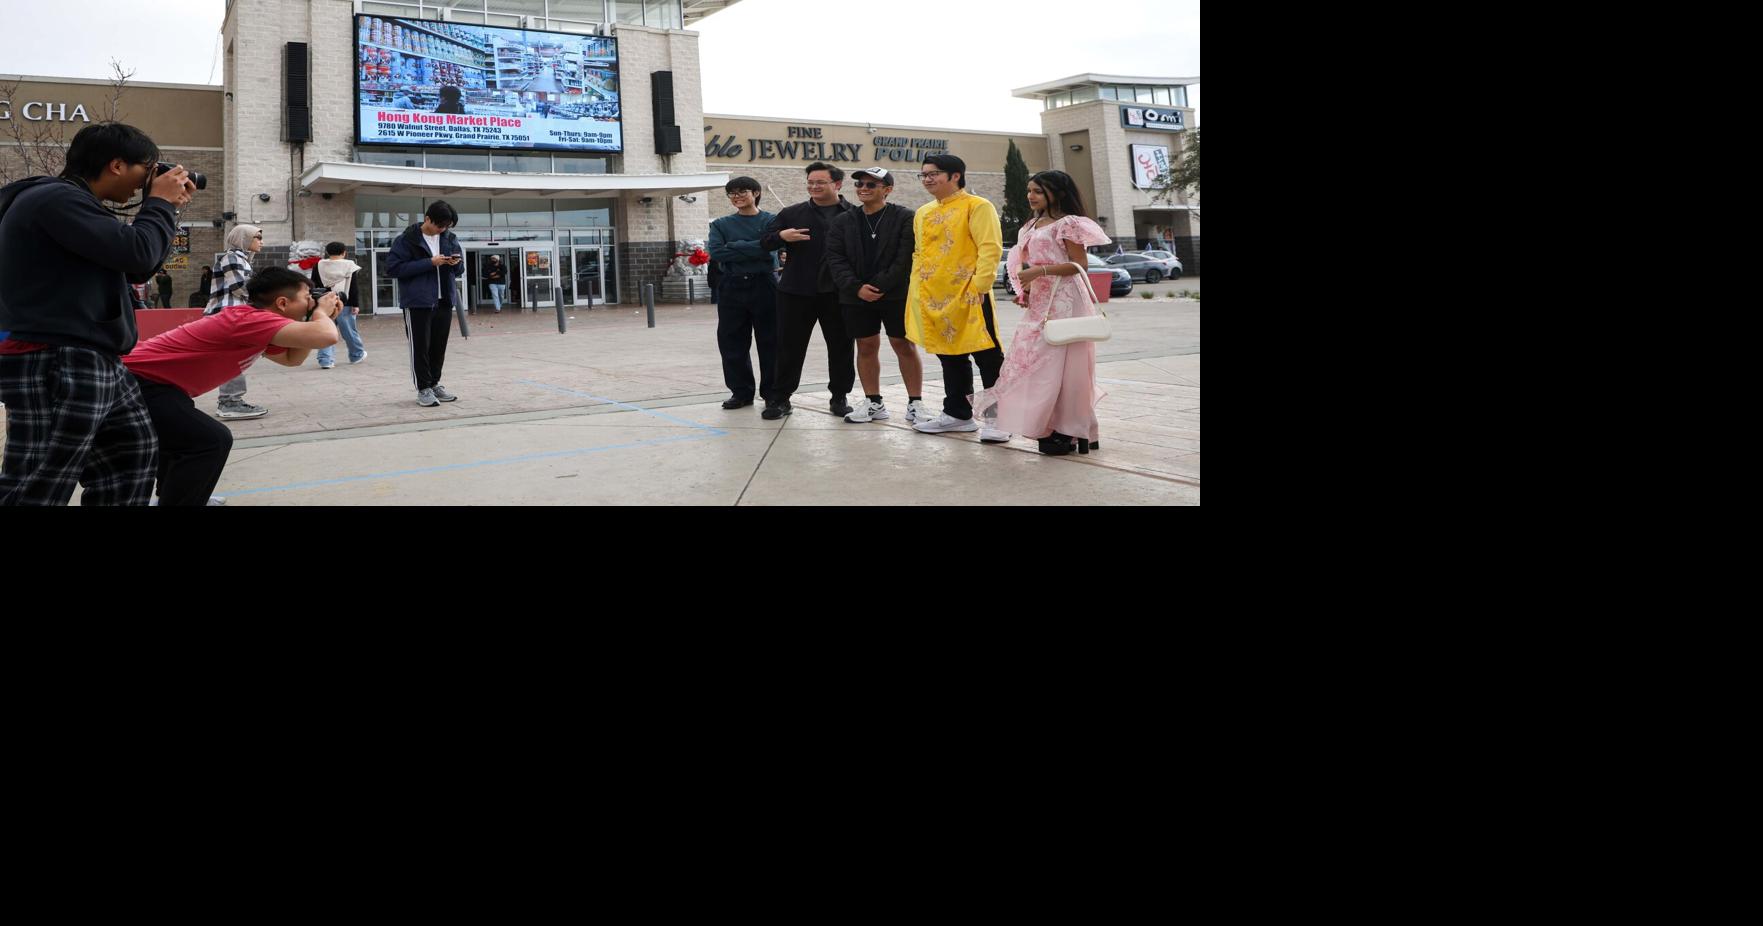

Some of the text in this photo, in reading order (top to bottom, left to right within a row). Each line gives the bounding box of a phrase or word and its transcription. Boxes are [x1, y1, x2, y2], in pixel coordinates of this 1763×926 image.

[22, 101, 90, 122] CHA
[378, 111, 521, 128] Hong Kong Market Place
[378, 122, 396, 130] 9780
[396, 123, 423, 131] Walnut
[787, 126, 823, 139] FINE
[405, 130, 433, 138] Pioneer
[455, 132, 476, 140] Grand
[704, 125, 863, 162] ble JEWELRY
[873, 136, 949, 149] GRAND PRAIRIE
